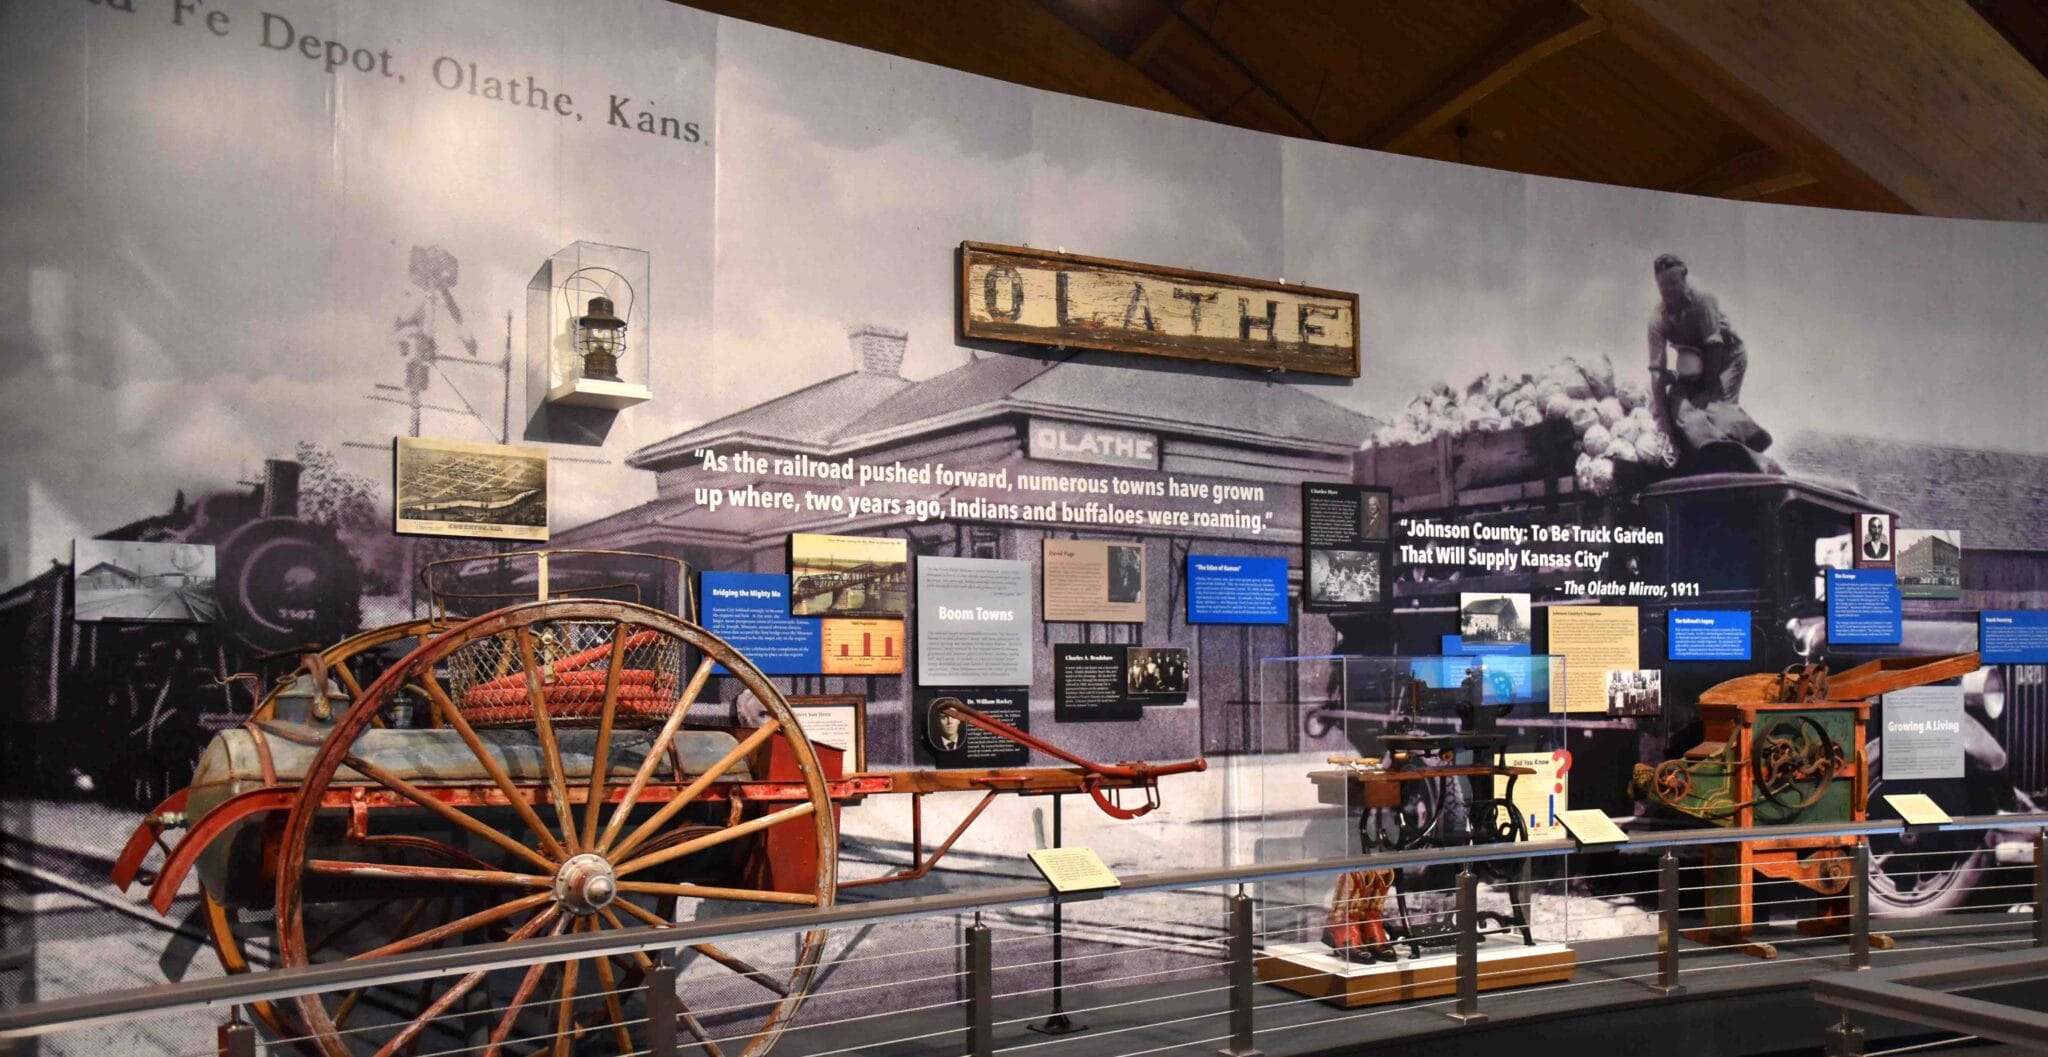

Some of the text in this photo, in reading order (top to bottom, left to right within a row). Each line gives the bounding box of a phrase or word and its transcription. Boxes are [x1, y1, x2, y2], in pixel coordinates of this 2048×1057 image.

[171, 0, 710, 147] Fe Depot, Olathe, Kans.
[983, 264, 1340, 344] OLATHE
[1035, 428, 1154, 460] OLATHE
[694, 449, 1264, 504] “As the railroad pushed forward, numerous towns have grown
[694, 485, 1273, 534] up where, two years ago, Indians and buffaloes were roaming.”
[1400, 518, 1664, 545] “Johnson County: To Be Truck Garden
[1400, 545, 1609, 572] That Will Supply Kansas City”
[712, 589, 739, 598] Bridging
[739, 589, 749, 597] the
[750, 590, 771, 599] Mighty
[1564, 580, 1586, 595] The
[1587, 580, 1627, 597] Olathe
[1628, 581, 1668, 598] Mirror,
[1670, 582, 1700, 597] 1911
[939, 606, 1014, 621] Boom Towns
[1888, 719, 1960, 734] Growing A Living
